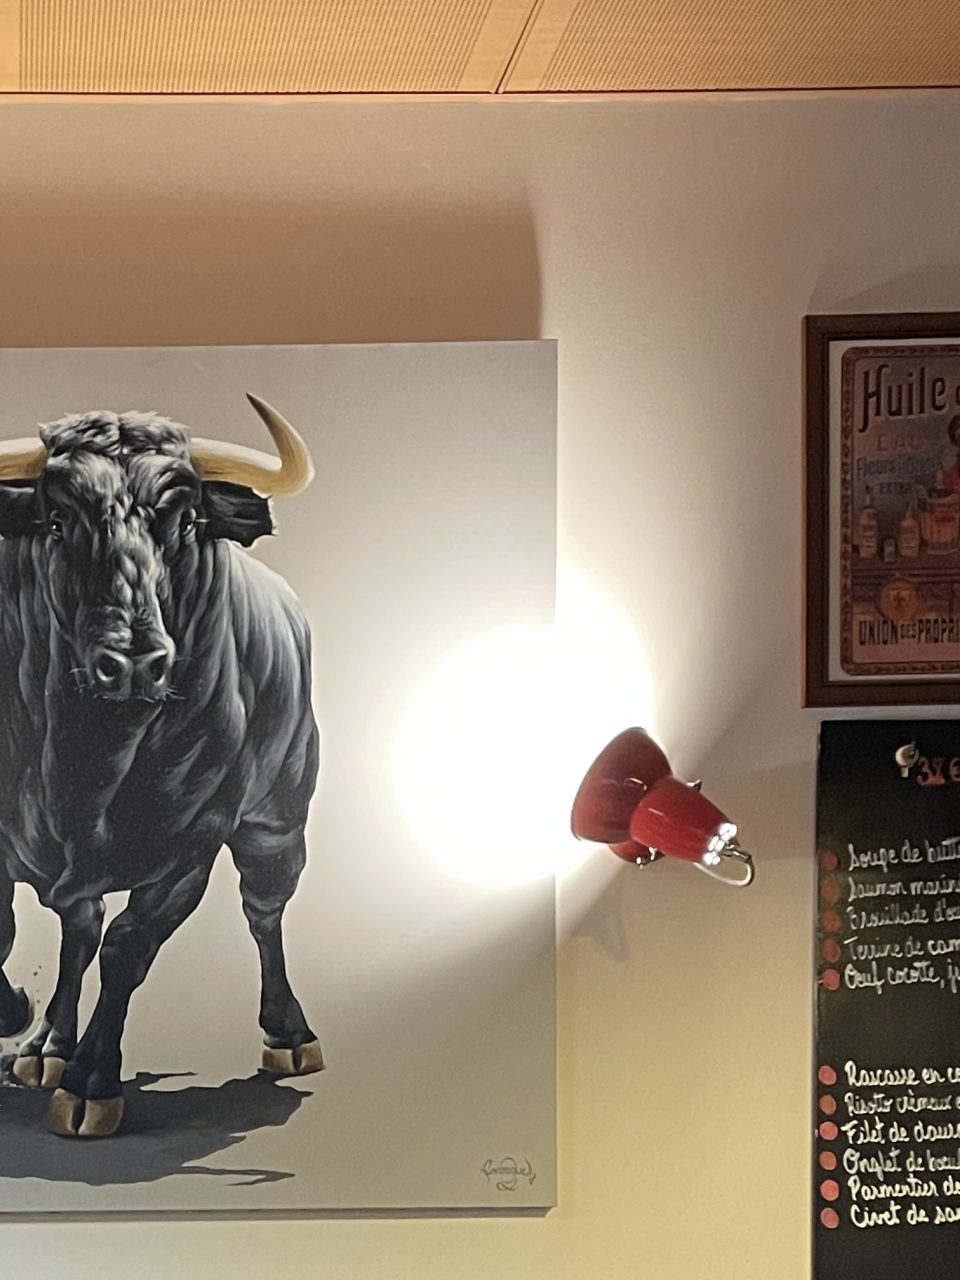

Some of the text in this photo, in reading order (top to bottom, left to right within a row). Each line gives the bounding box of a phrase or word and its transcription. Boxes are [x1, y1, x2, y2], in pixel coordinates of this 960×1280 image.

[858, 364, 948, 433] Huile
[858, 619, 898, 645] UNION
[848, 843, 899, 873] Soupe
[901, 839, 923, 863] de
[848, 876, 907, 902] Saumon
[846, 903, 929, 930] Brouillade
[843, 935, 903, 960] Terrine
[905, 936, 924, 957] de
[844, 1060, 920, 1086] Rascasse
[922, 1067, 945, 1084] en
[844, 1092, 893, 1116] Risotto
[889, 1121, 910, 1142] de
[843, 1146, 902, 1181] Onglet
[906, 1150, 925, 1172] de
[848, 1173, 939, 1201] Parmentier
[850, 1200, 902, 1228] Civet
[907, 1203, 929, 1225] de
